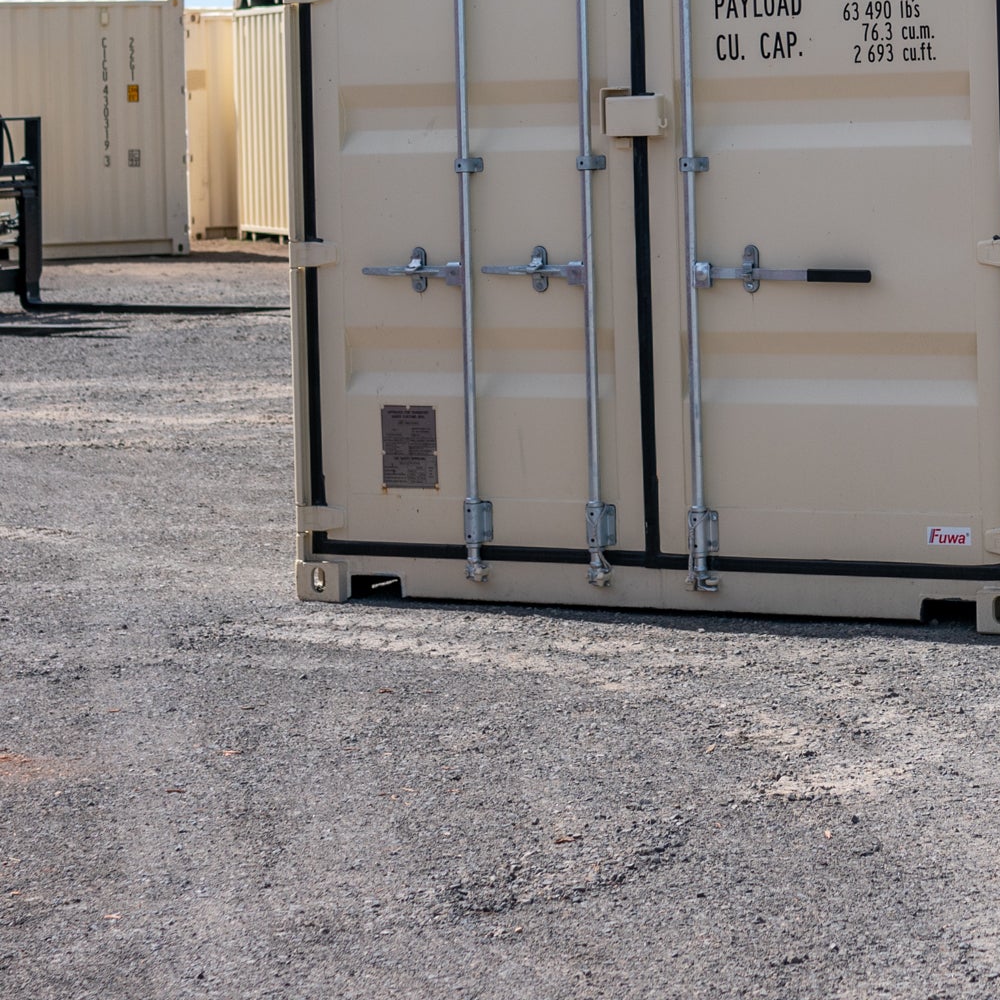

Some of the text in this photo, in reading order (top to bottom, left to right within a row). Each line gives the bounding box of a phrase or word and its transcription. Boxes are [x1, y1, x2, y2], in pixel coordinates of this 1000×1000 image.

[843, 1, 921, 21] 63 490 lbs
[862, 24, 935, 42] 76.3 cu.m.
[716, 31, 803, 61] CU. CAP.
[854, 44, 937, 63] 2 693 cu.ft.
